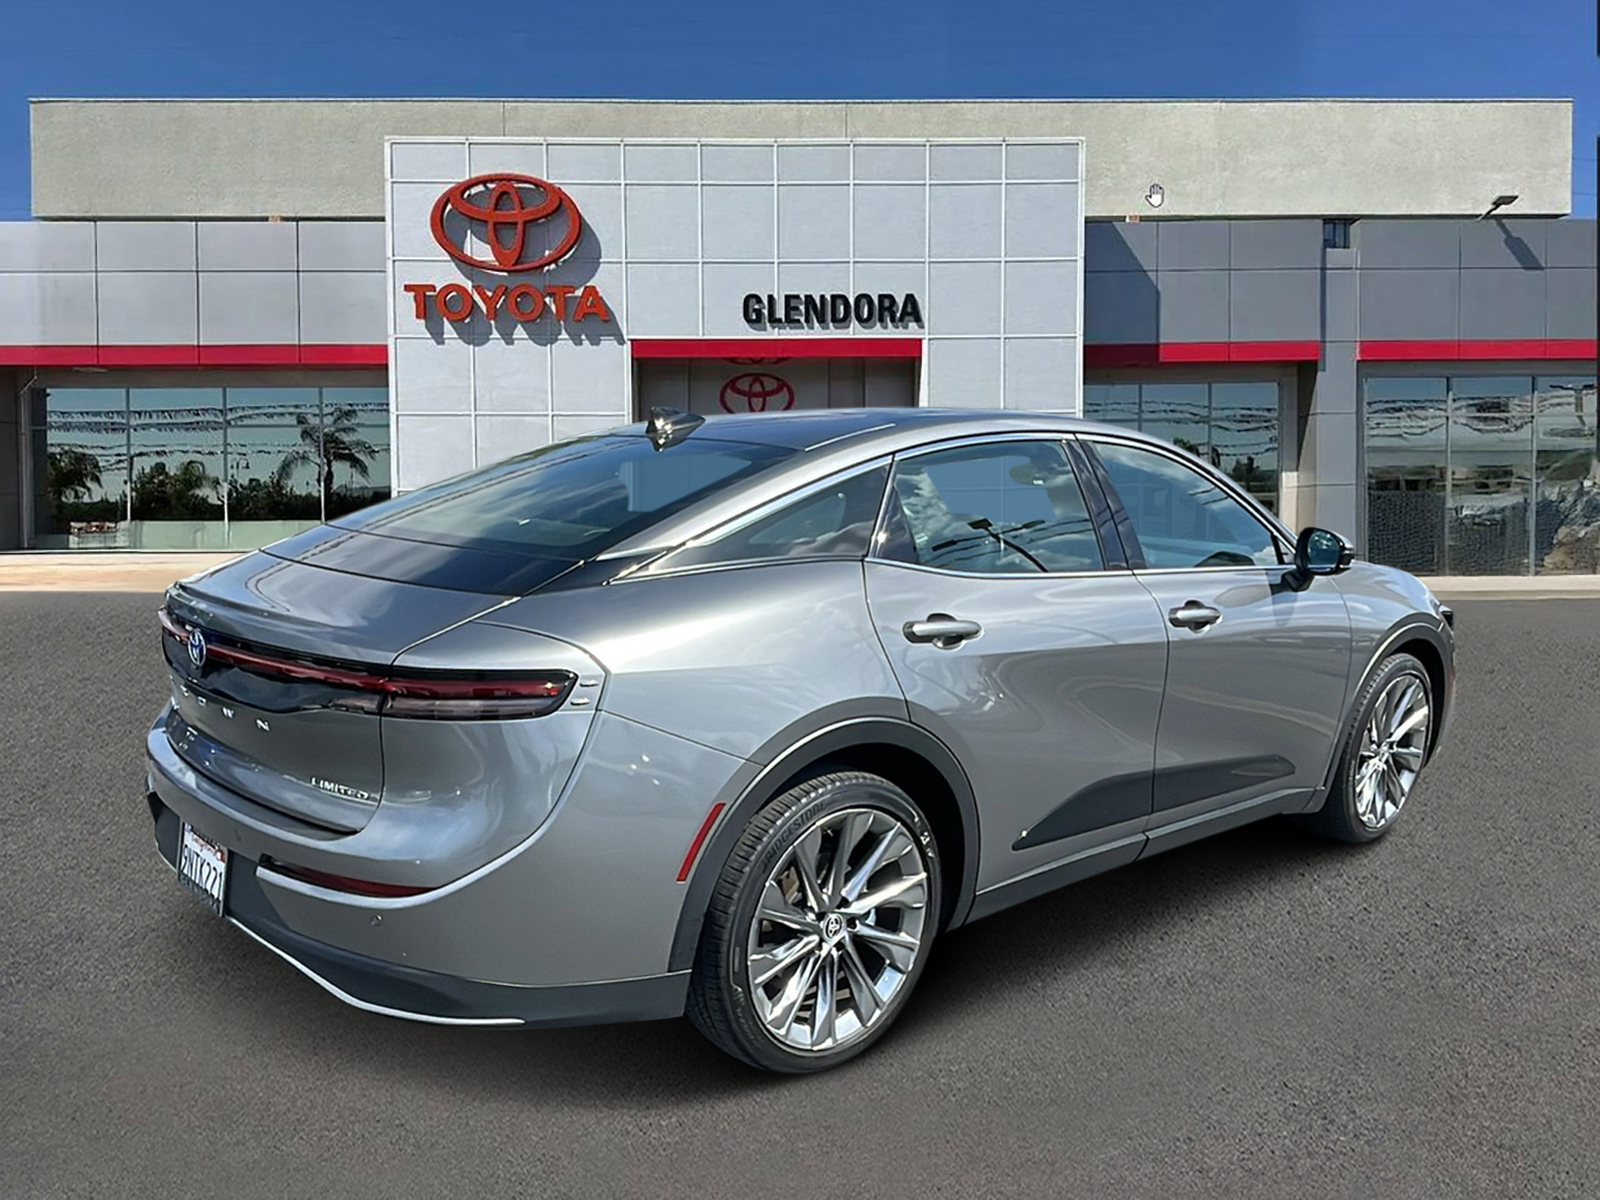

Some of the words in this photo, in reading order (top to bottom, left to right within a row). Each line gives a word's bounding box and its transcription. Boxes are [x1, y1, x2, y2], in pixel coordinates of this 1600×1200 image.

[404, 284, 609, 322] TOYOTA
[742, 293, 922, 325] GLENDORA
[311, 776, 370, 800] LIMITED
